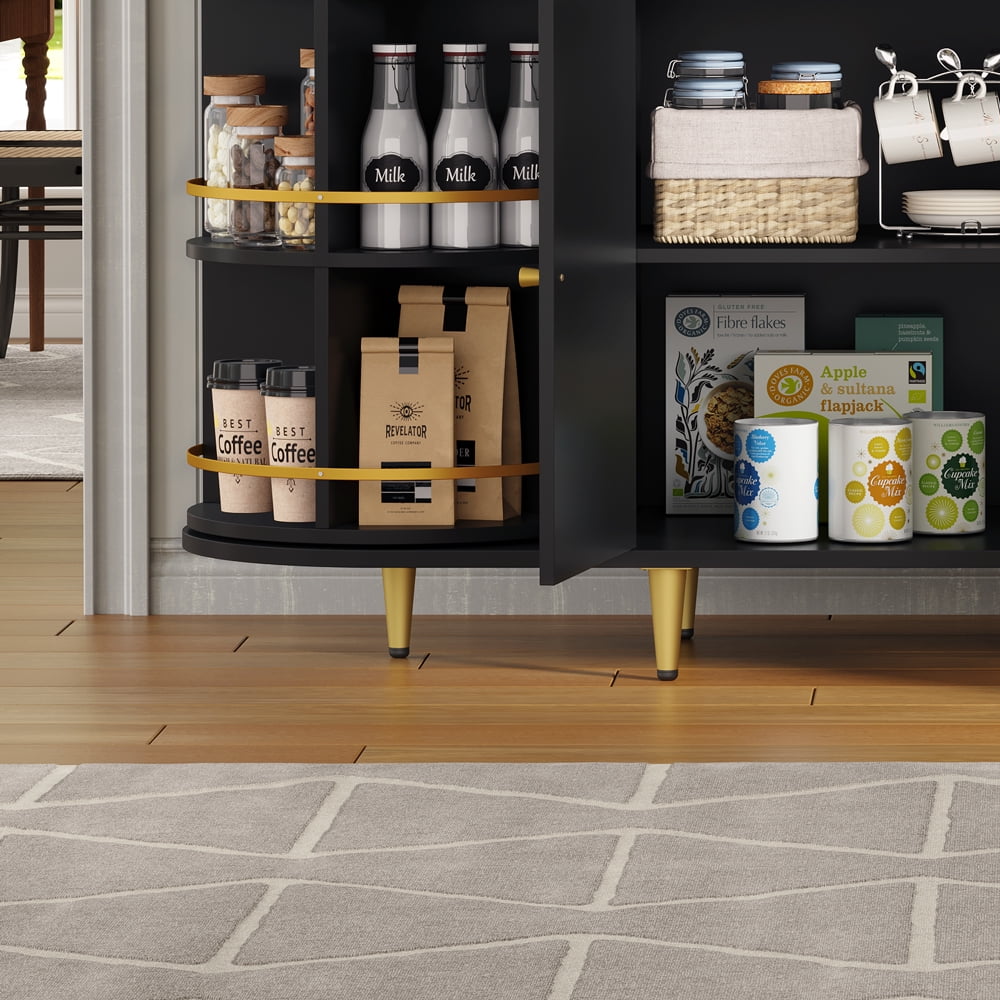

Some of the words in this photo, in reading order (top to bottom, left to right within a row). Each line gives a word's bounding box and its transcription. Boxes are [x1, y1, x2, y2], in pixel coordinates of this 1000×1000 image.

[375, 166, 406, 183] Milk
[446, 165, 476, 182] Milk
[717, 315, 748, 329] Fibre
[751, 315, 786, 329] flakes
[769, 367, 788, 392] DOVES
[790, 367, 810, 383] FARM
[820, 365, 867, 381] Apple
[773, 386, 811, 404] ORGANIC
[820, 382, 833, 395] &
[837, 382, 896, 395] sultana
[820, 399, 884, 415] flapjack
[222, 418, 252, 429] BEST
[275, 426, 305, 437] BEST
[385, 424, 427, 439] REVELATOR
[218, 433, 262, 454] Coffee
[271, 442, 316, 463] Coffee
[943, 467, 978, 480] Cupcake
[871, 475, 904, 488] Cupcake
[954, 479, 976, 490] Mix
[881, 486, 902, 498] Mix
